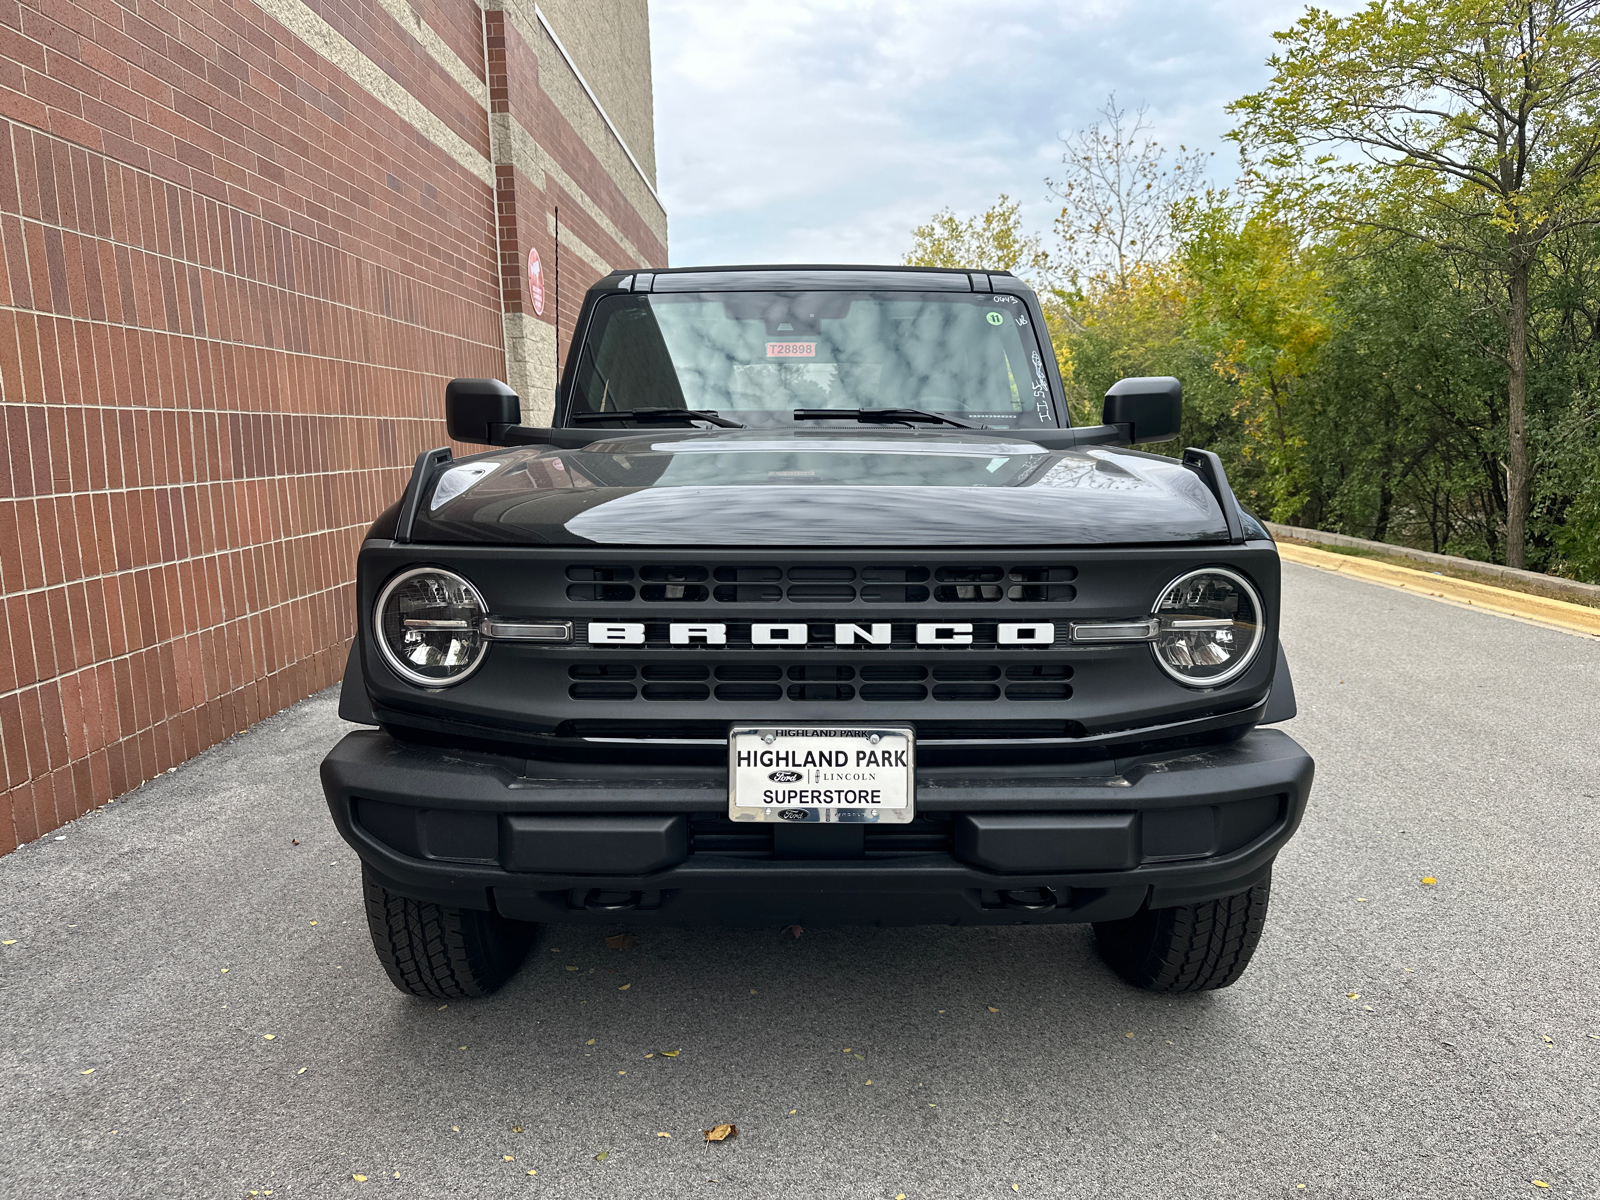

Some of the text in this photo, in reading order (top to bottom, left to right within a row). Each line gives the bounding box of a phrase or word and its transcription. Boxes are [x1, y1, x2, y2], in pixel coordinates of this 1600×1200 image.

[990, 314, 1000, 323] 11
[769, 344, 812, 354] T28898
[588, 622, 1055, 645] BRONCO
[775, 729, 869, 738] HIGHLAND PARK
[737, 750, 908, 768] HIGHLAND PARK
[772, 770, 876, 782] Ford LINCOLN
[763, 789, 881, 804] SUPERSTORE
[782, 809, 805, 820] Ford
